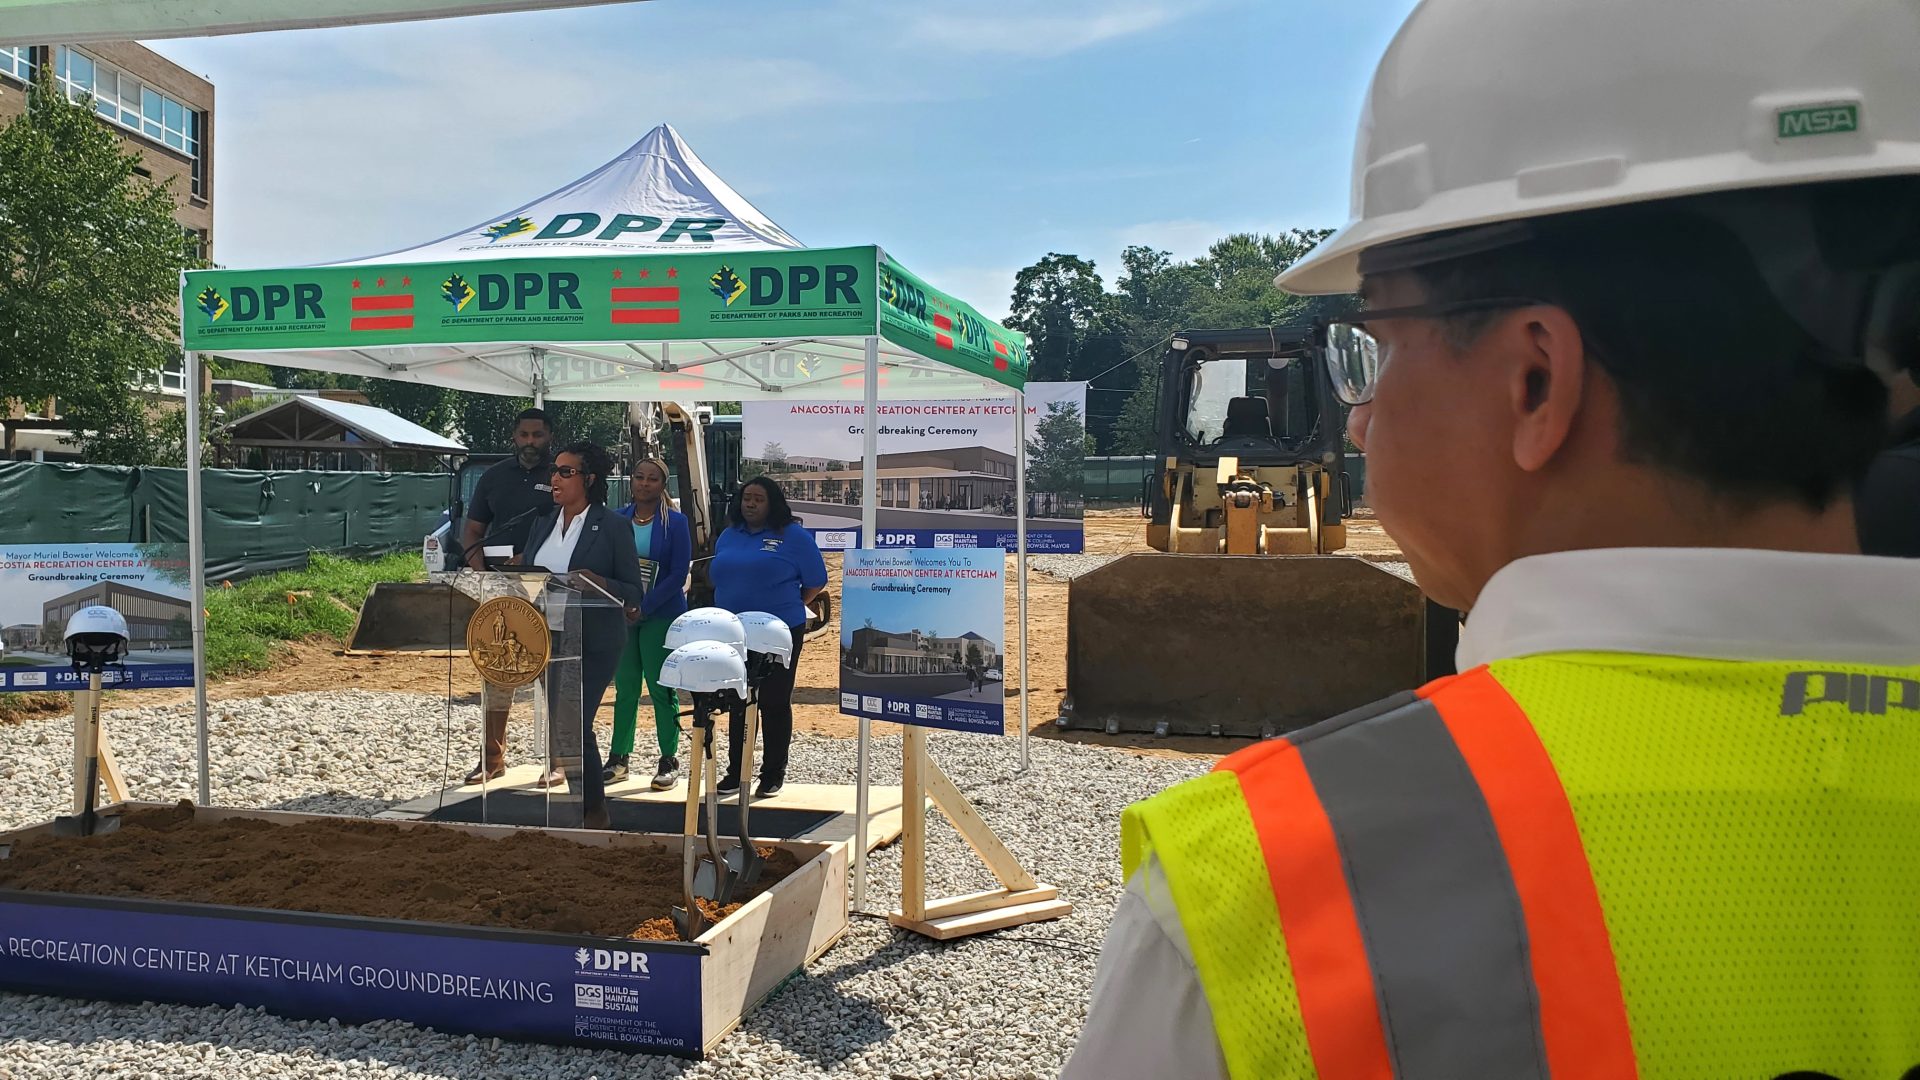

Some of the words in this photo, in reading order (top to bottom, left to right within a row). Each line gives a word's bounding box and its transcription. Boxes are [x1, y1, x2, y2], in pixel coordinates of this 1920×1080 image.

[1784, 110, 1854, 134] MSA
[532, 212, 726, 242] DPR
[750, 264, 861, 306] DPR
[478, 272, 582, 311] DPR
[230, 283, 326, 321] DPR
[895, 278, 928, 326] DPR
[962, 312, 990, 352] DPR
[790, 405, 851, 414] ANACOSTIA
[854, 406, 920, 414] REREATION
[924, 406, 966, 415] CENTER
[968, 406, 981, 414] AT
[848, 426, 925, 437] Grodbreaking
[928, 426, 978, 436] Ceremony
[825, 533, 846, 542] CCC
[886, 534, 916, 544] DPR
[6, 552, 31, 560] Mayor
[34, 551, 60, 559] Muriel
[860, 558, 874, 567] Mayor
[875, 557, 891, 566] Muriel
[893, 557, 913, 566] Bowser
[914, 557, 946, 566] Welcomes
[948, 557, 961, 566] You
[963, 558, 972, 566] To
[28, 573, 97, 581] Groundbreaking
[100, 573, 145, 581] Ceremony
[875, 569, 913, 577] RECREATION
[915, 569, 943, 577] CENTER
[944, 570, 953, 578] AT
[956, 570, 997, 579] KETCHAM
[871, 583, 916, 594] Groundbreaking
[917, 584, 951, 595] Ceremony
[893, 701, 910, 713] DPR
[594, 949, 649, 973] DPR
[9, 937, 126, 966] RECREATION
[133, 948, 210, 973] CENTER
[216, 954, 240, 975] AT
[246, 955, 344, 984] KETCHAM
[350, 965, 553, 1003] GROUNDBREAKING
[577, 987, 601, 998] DGS
[605, 985, 628, 995] BUILD
[605, 994, 638, 1004] MAINTAIN
[605, 1002, 638, 1012] SUSTAIN
[590, 1016, 632, 1026] GOVERNMENT
[575, 1028, 590, 1037] DC
[628, 1027, 661, 1035] COLUMBIA
[590, 1032, 618, 1040] MURIEL
[620, 1033, 655, 1045] BOWSER,
[657, 1038, 684, 1047] MAYOR
